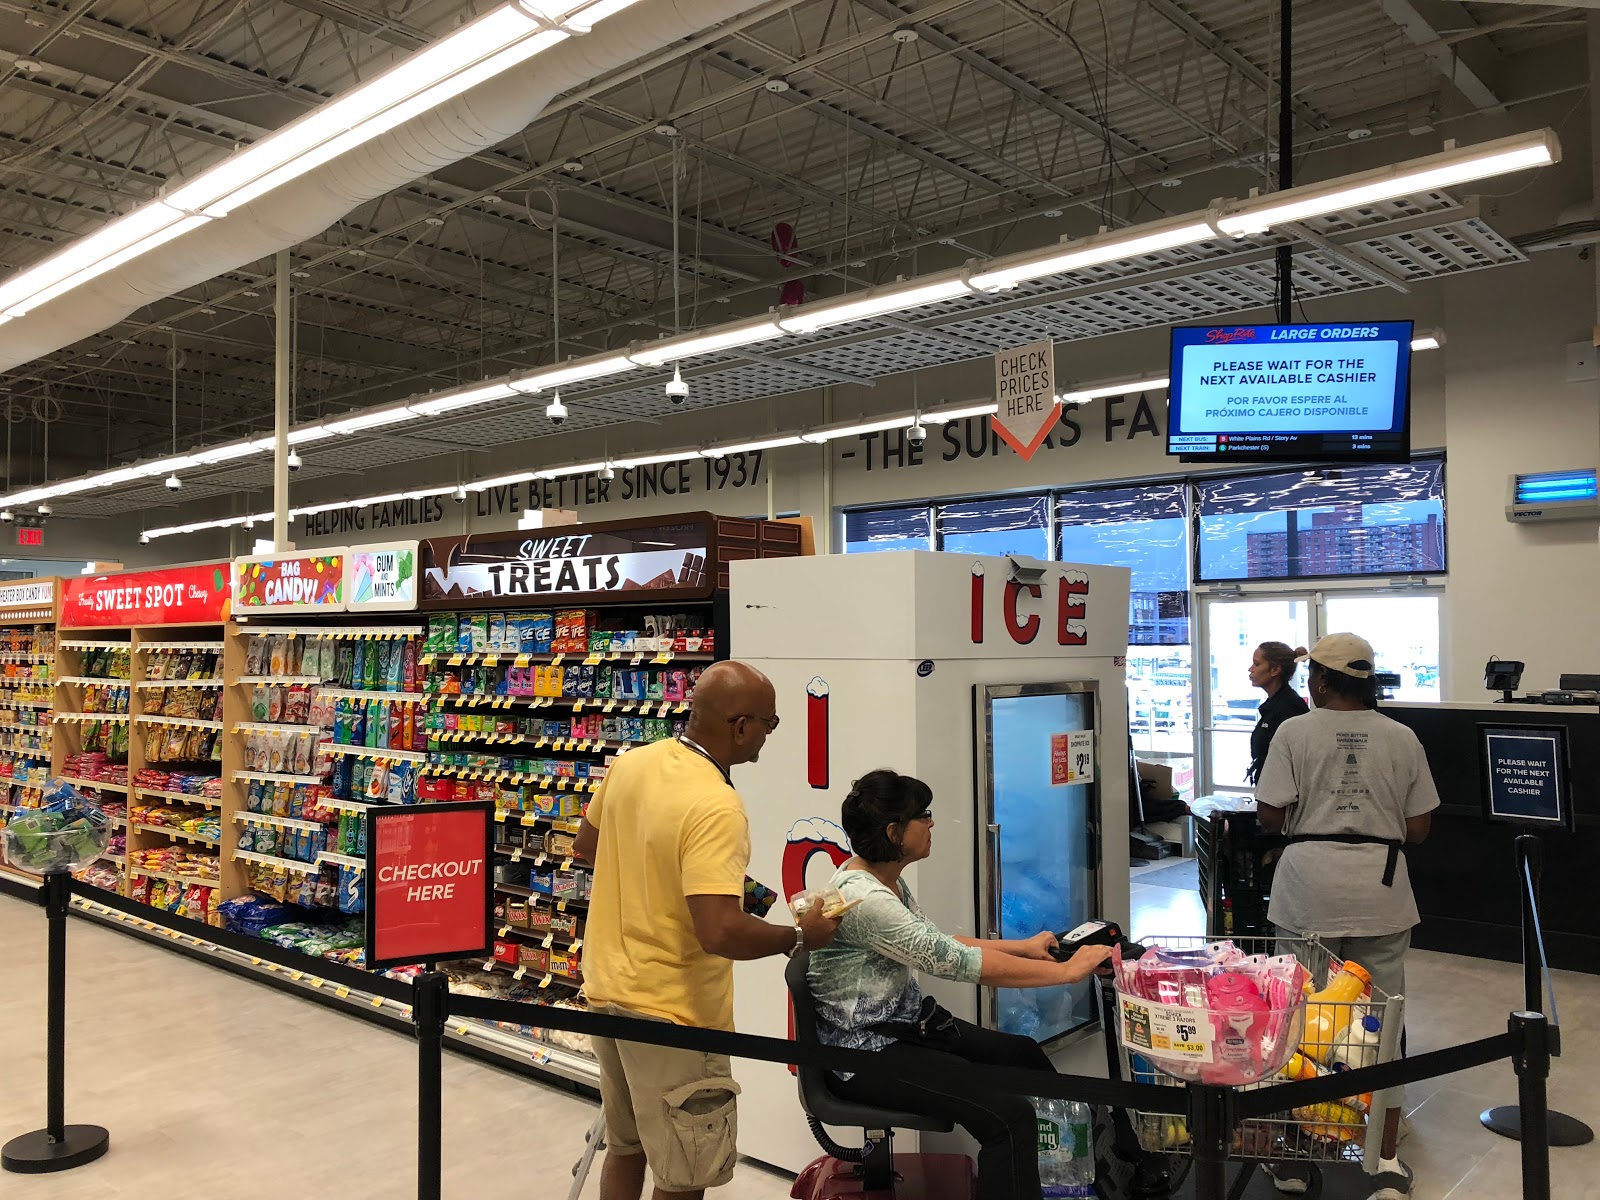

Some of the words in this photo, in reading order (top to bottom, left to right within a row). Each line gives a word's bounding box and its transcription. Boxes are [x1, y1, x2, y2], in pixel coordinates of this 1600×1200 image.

[1205, 327, 1256, 344] ShopRite
[1270, 328, 1317, 340] LARGE
[1320, 327, 1379, 339] ORDERS
[1001, 350, 1047, 377] CHECK
[1213, 361, 1263, 371] PLEASE
[1267, 360, 1301, 371] WAIT
[1305, 359, 1333, 370] FOR
[1338, 358, 1365, 369] THE
[1000, 370, 1049, 398] PRICES
[1200, 375, 1235, 385] NEXT
[1239, 373, 1313, 385] AVAILABLE
[1316, 372, 1377, 383] CASHIER
[1007, 392, 1043, 417] HERE
[1227, 396, 1249, 405] POR
[1252, 396, 1288, 405] FAVOR
[1290, 395, 1332, 404] ESPERE
[1333, 395, 1347, 404] AL
[1205, 407, 1256, 417] PRÓXIMO
[1258, 408, 1301, 417] CAJERO
[1304, 407, 1369, 416] DISPONIBLE
[305, 506, 365, 537] HELPING
[371, 495, 443, 529] FAMILIES
[477, 483, 519, 517] LIVE
[528, 472, 610, 510] BETTER
[621, 460, 690, 500] SINCE
[20, 529, 42, 545] EXIT
[516, 534, 593, 561] SWEET
[280, 561, 300, 577] BAG
[376, 555, 394, 572] GUM
[487, 555, 620, 595] TREATS
[16, 588, 25, 602] BOX
[26, 586, 40, 601] CANDY
[95, 587, 142, 611] SWEET
[145, 583, 184, 608] SPOT
[188, 584, 208, 604] Chewy
[264, 577, 319, 605] CANDY!
[374, 583, 395, 597] MINTS
[971, 561, 1089, 645] ICE
[1498, 758, 1525, 766] PLEASE
[1529, 769, 1550, 777] NEXT
[1503, 777, 1544, 786] AVAILABLE
[1507, 787, 1541, 796] CASHIER
[378, 859, 482, 883] CHECKOUT
[406, 883, 456, 902] HERE
[1186, 1044, 1204, 1052] $3.00
